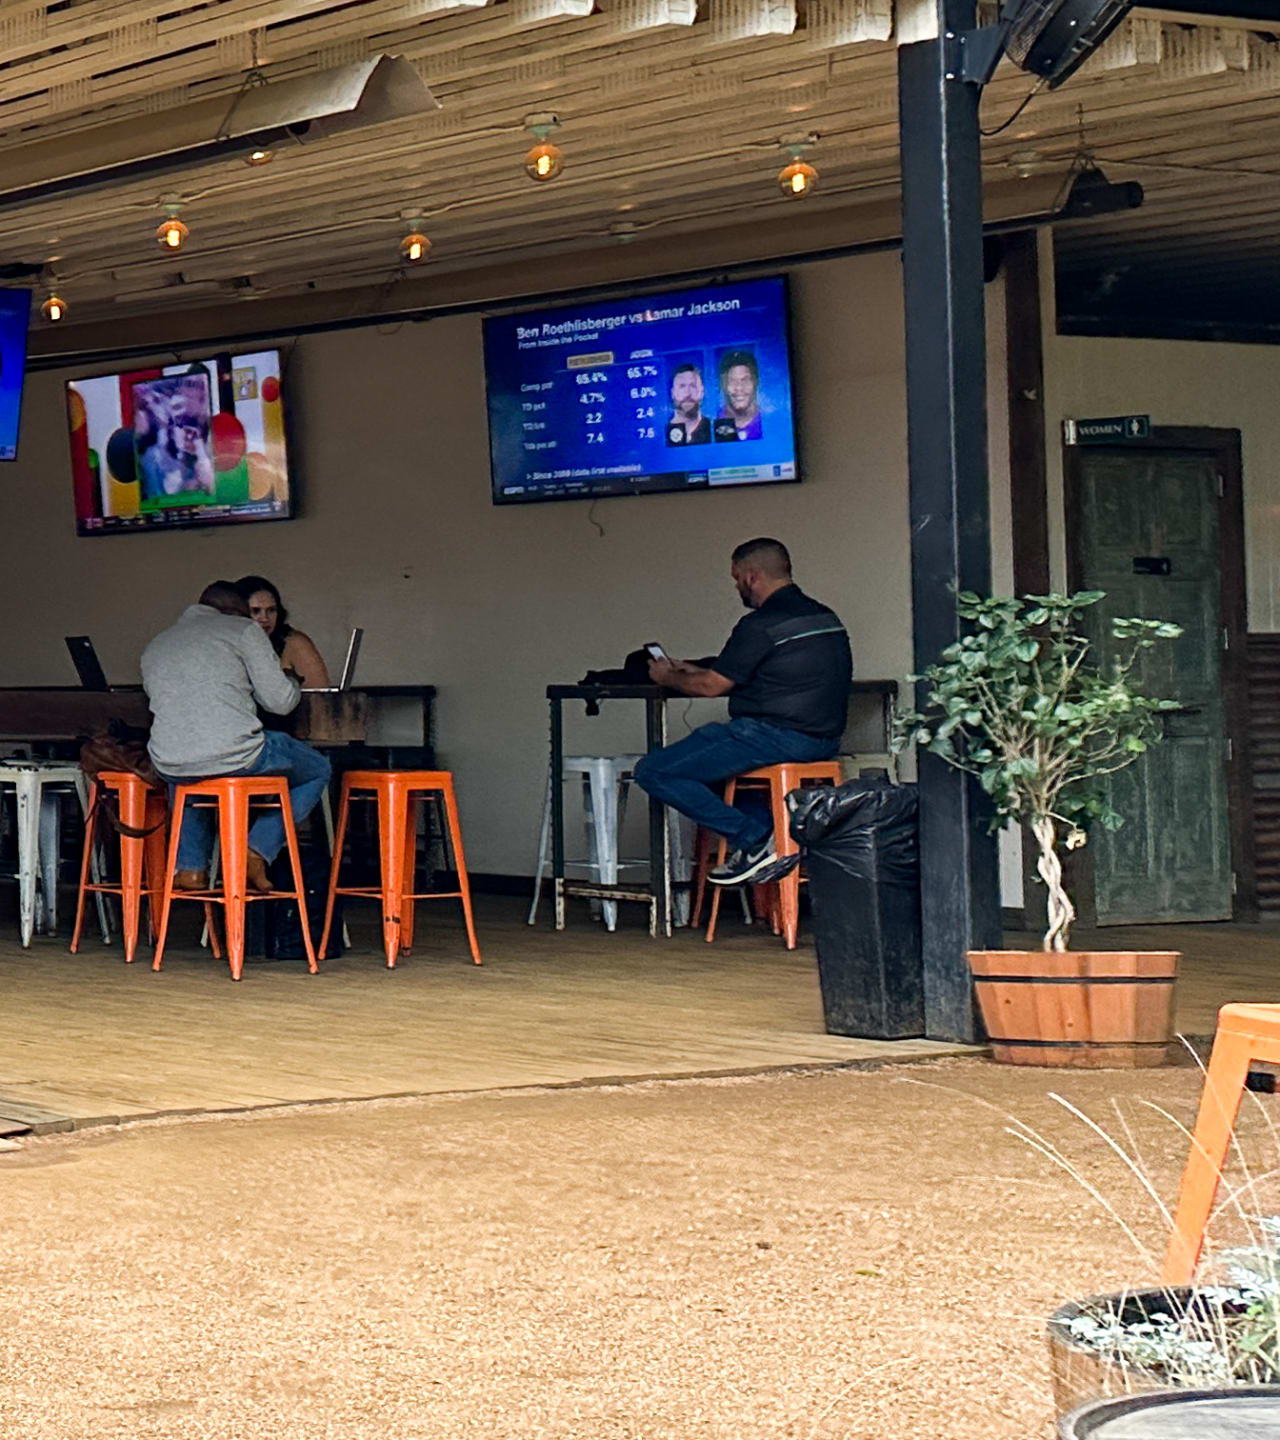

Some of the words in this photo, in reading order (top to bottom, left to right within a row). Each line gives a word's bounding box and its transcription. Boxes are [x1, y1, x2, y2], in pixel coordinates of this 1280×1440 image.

[516, 327, 539, 339] Ben
[629, 314, 643, 323] vs
[645, 306, 685, 322] Lamar
[687, 299, 740, 316] Jackson
[1079, 425, 1122, 436] WOMEN
[586, 432, 604, 444] 7.4
